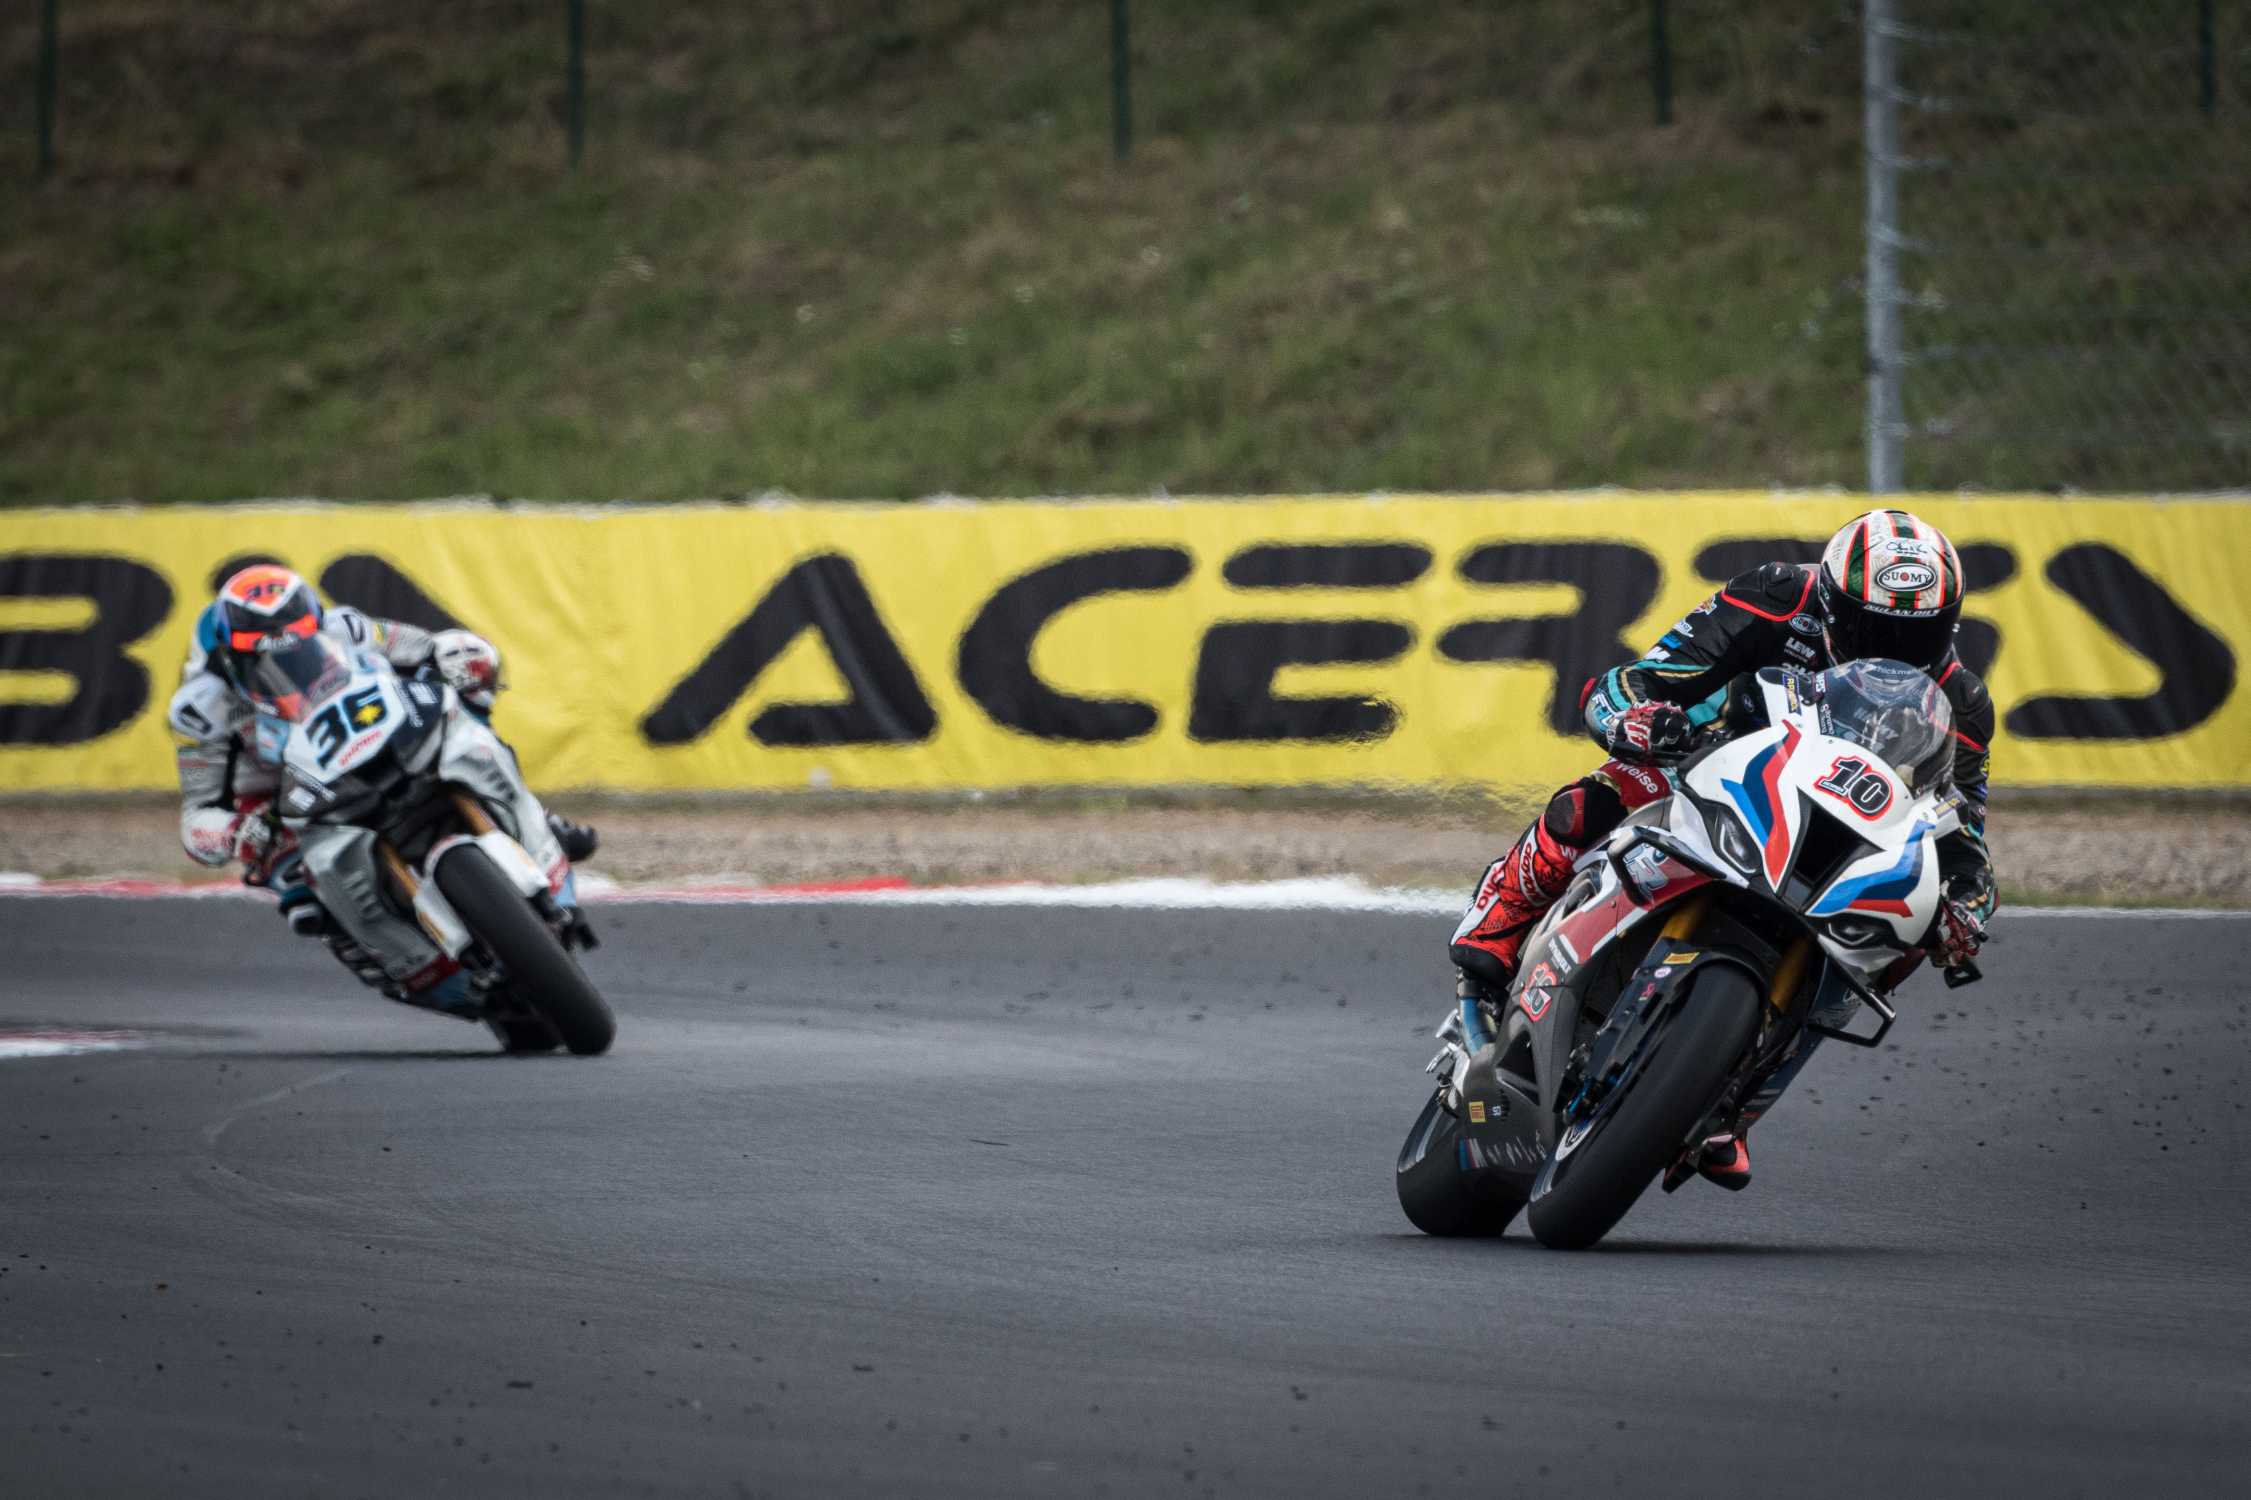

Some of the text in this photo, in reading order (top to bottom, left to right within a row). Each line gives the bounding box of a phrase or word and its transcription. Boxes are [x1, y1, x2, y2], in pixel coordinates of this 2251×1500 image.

[1882, 570, 1931, 583] SUOMY
[304, 684, 388, 771] 36
[1816, 757, 1892, 818] 10
